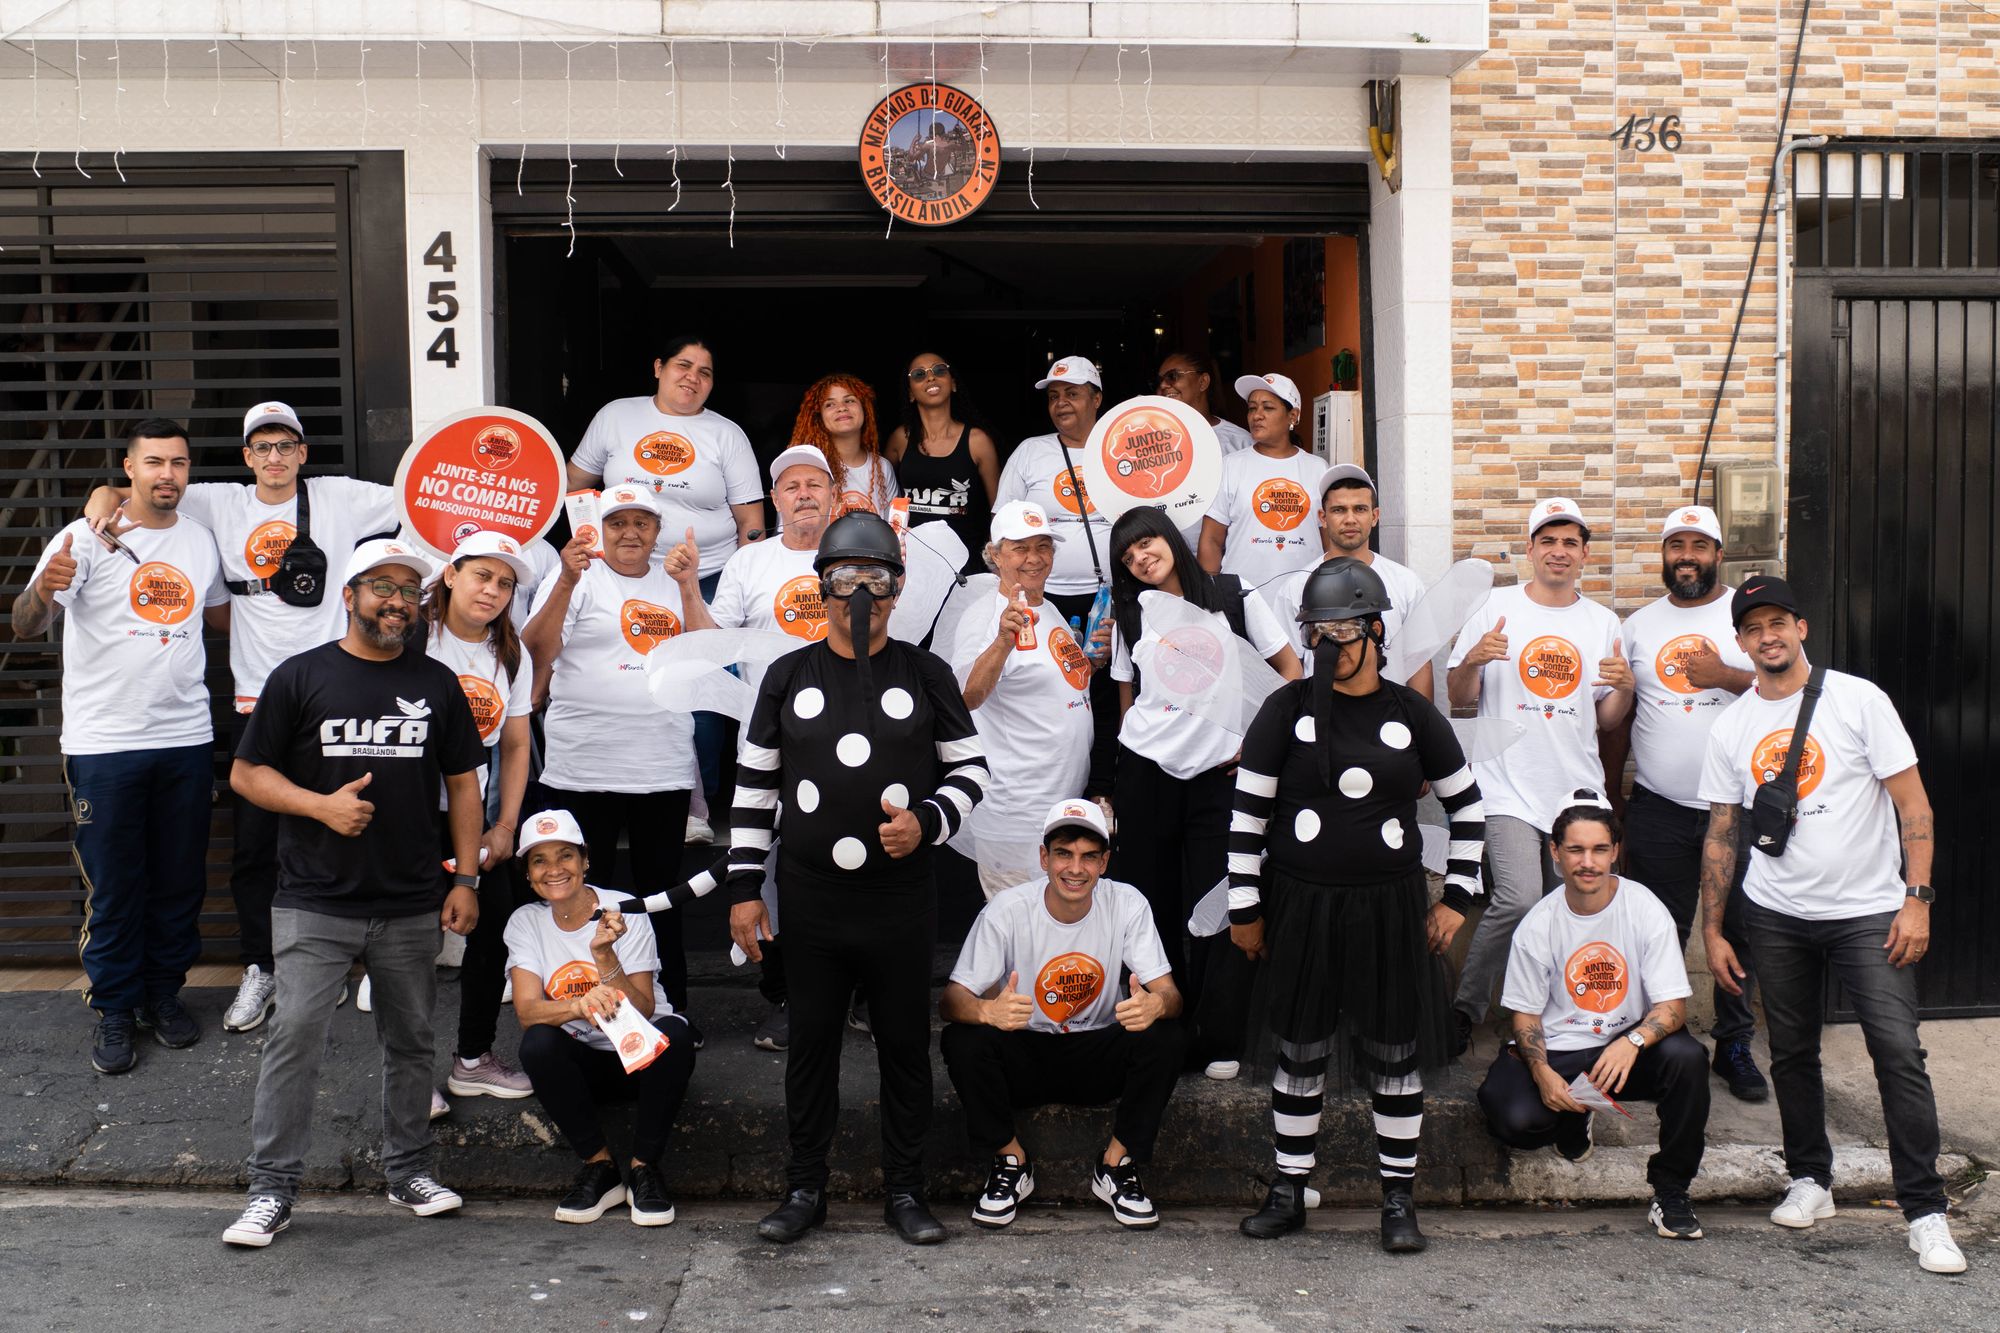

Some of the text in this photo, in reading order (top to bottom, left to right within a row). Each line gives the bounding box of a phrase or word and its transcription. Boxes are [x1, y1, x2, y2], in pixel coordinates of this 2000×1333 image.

[864, 91, 916, 148] MENINOS
[920, 88, 940, 106] DO
[1609, 113, 1682, 152] 136
[866, 165, 973, 221] BRASILÂNDIA
[975, 159, 996, 184] ZN
[1125, 428, 1172, 450] JUNTOS
[652, 443, 685, 453] JUNTOS
[656, 449, 682, 457] contra
[1135, 442, 1172, 459] contra
[1133, 450, 1183, 472] MOSQUITO
[433, 462, 538, 495] JUNTE-SE A NÓS
[418, 475, 541, 517] NO COMBATE
[414, 496, 533, 529] AO MOSQUITO DA DENGUE
[1270, 505, 1303, 513] MOSQUITO
[147, 580, 182, 589] JUNTOS
[153, 589, 179, 598] contra
[793, 594, 822, 603] JUNTO
[800, 602, 828, 610] contr
[644, 619, 669, 627] contra
[1538, 653, 1572, 664] JUNTOS
[1543, 662, 1569, 672] contra
[1540, 669, 1574, 682] MOSQUITO
[468, 697, 493, 707] NTOS
[472, 707, 490, 716] ntra
[320, 718, 429, 744] CUFA
[352, 747, 397, 756] BRASILÂNDIA
[1583, 962, 1616, 976] JUNTOS
[1056, 973, 1093, 986] JUNTOS
[1589, 972, 1614, 980] contra
[564, 981, 599, 995] JUNTOS
[1063, 983, 1091, 993] contra
[1587, 980, 1622, 990] MOSQUITO
